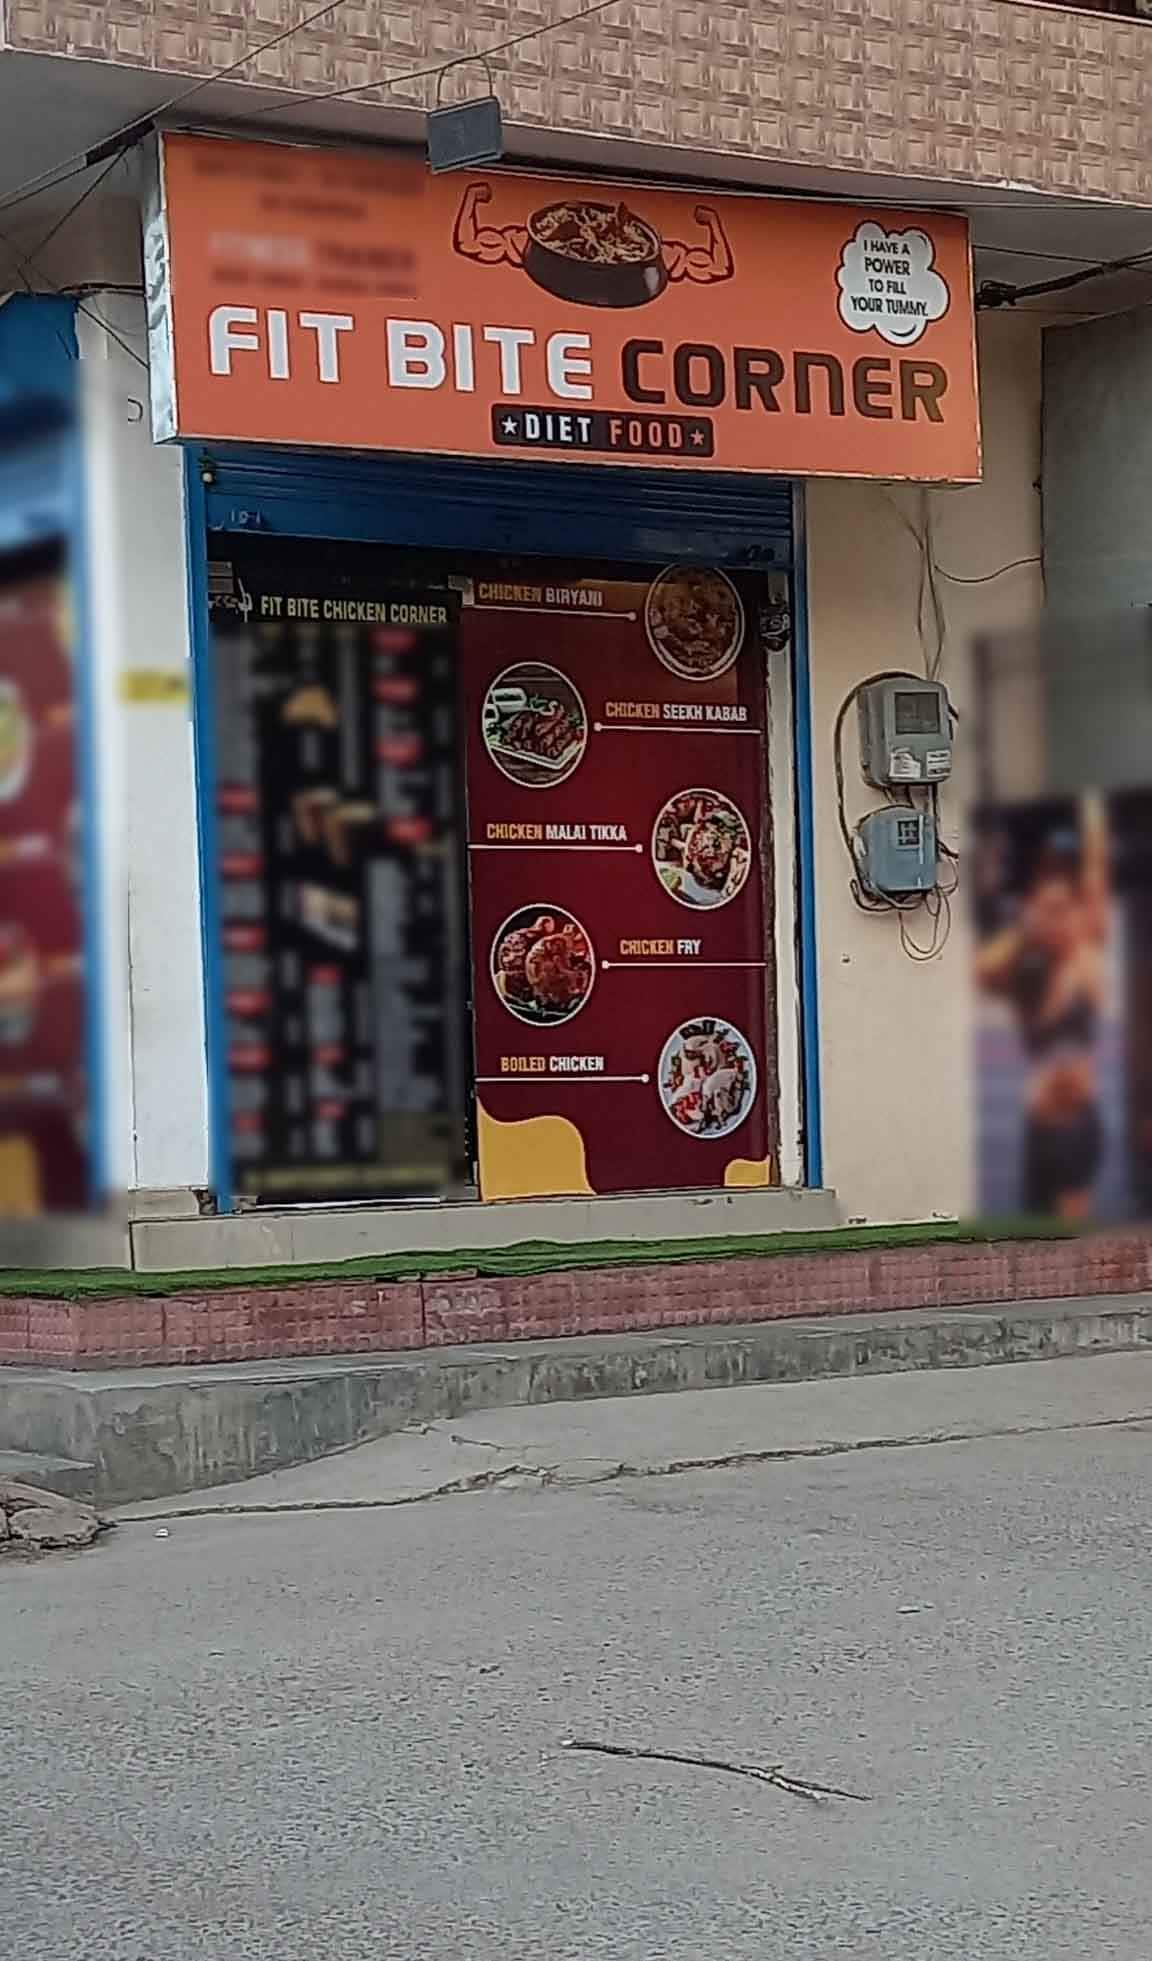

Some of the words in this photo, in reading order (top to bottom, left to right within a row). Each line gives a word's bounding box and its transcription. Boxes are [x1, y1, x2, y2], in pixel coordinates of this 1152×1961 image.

[864, 239, 868, 251] I
[870, 241, 898, 254] HAVE
[901, 243, 911, 255] A
[864, 256, 911, 275] POWER
[868, 278, 884, 292] TO
[886, 280, 906, 294] FILL
[850, 296, 882, 312] YOUR
[208, 305, 354, 383] FIT
[386, 316, 594, 400] BITE
[621, 339, 948, 422] CORNER
[524, 412, 592, 443] DIET
[609, 419, 682, 448] FOOD
[479, 583, 542, 603] CHICKEN
[546, 587, 603, 607] BIRYANI
[260, 595, 283, 616] FIT
[287, 598, 319, 619] BITE
[323, 599, 386, 623] CHICKEN
[390, 603, 447, 624] CORNER
[605, 702, 660, 719] CHICKEN
[663, 704, 702, 720] SEEKH
[705, 705, 748, 721] KABAB
[486, 823, 543, 840] CHICKEN
[545, 824, 586, 840] MALAI
[589, 824, 628, 841] TIKKA
[619, 939, 675, 955] CHICKEN
[676, 939, 702, 955] FRY
[500, 1055, 546, 1072] BOILED
[549, 1056, 604, 1072] CHICKEN
